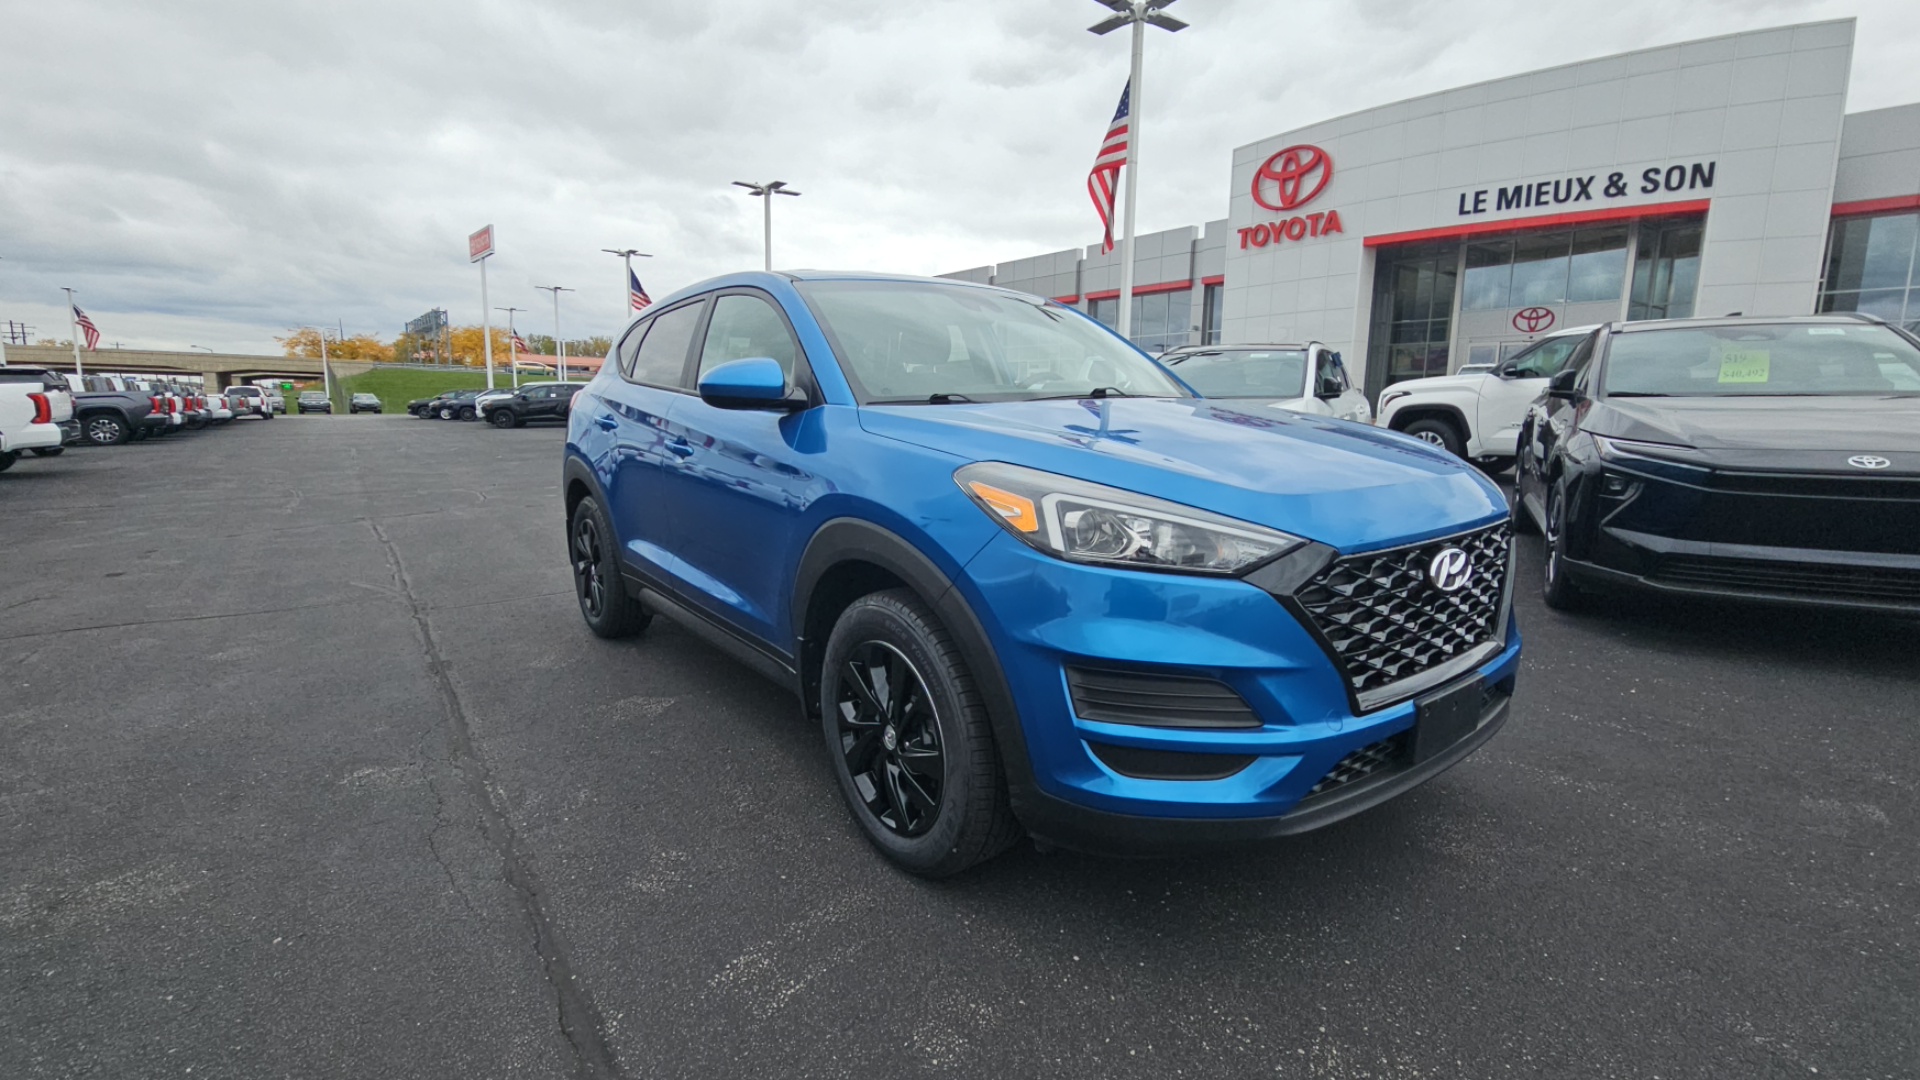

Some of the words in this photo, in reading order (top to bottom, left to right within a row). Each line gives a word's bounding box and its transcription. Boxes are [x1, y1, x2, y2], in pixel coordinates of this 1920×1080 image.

[1458, 190, 1488, 216] LE
[1496, 175, 1596, 211] MIEUX
[1603, 172, 1627, 198] &
[1641, 161, 1716, 195] SON
[1237, 209, 1343, 250] TOYOTA
